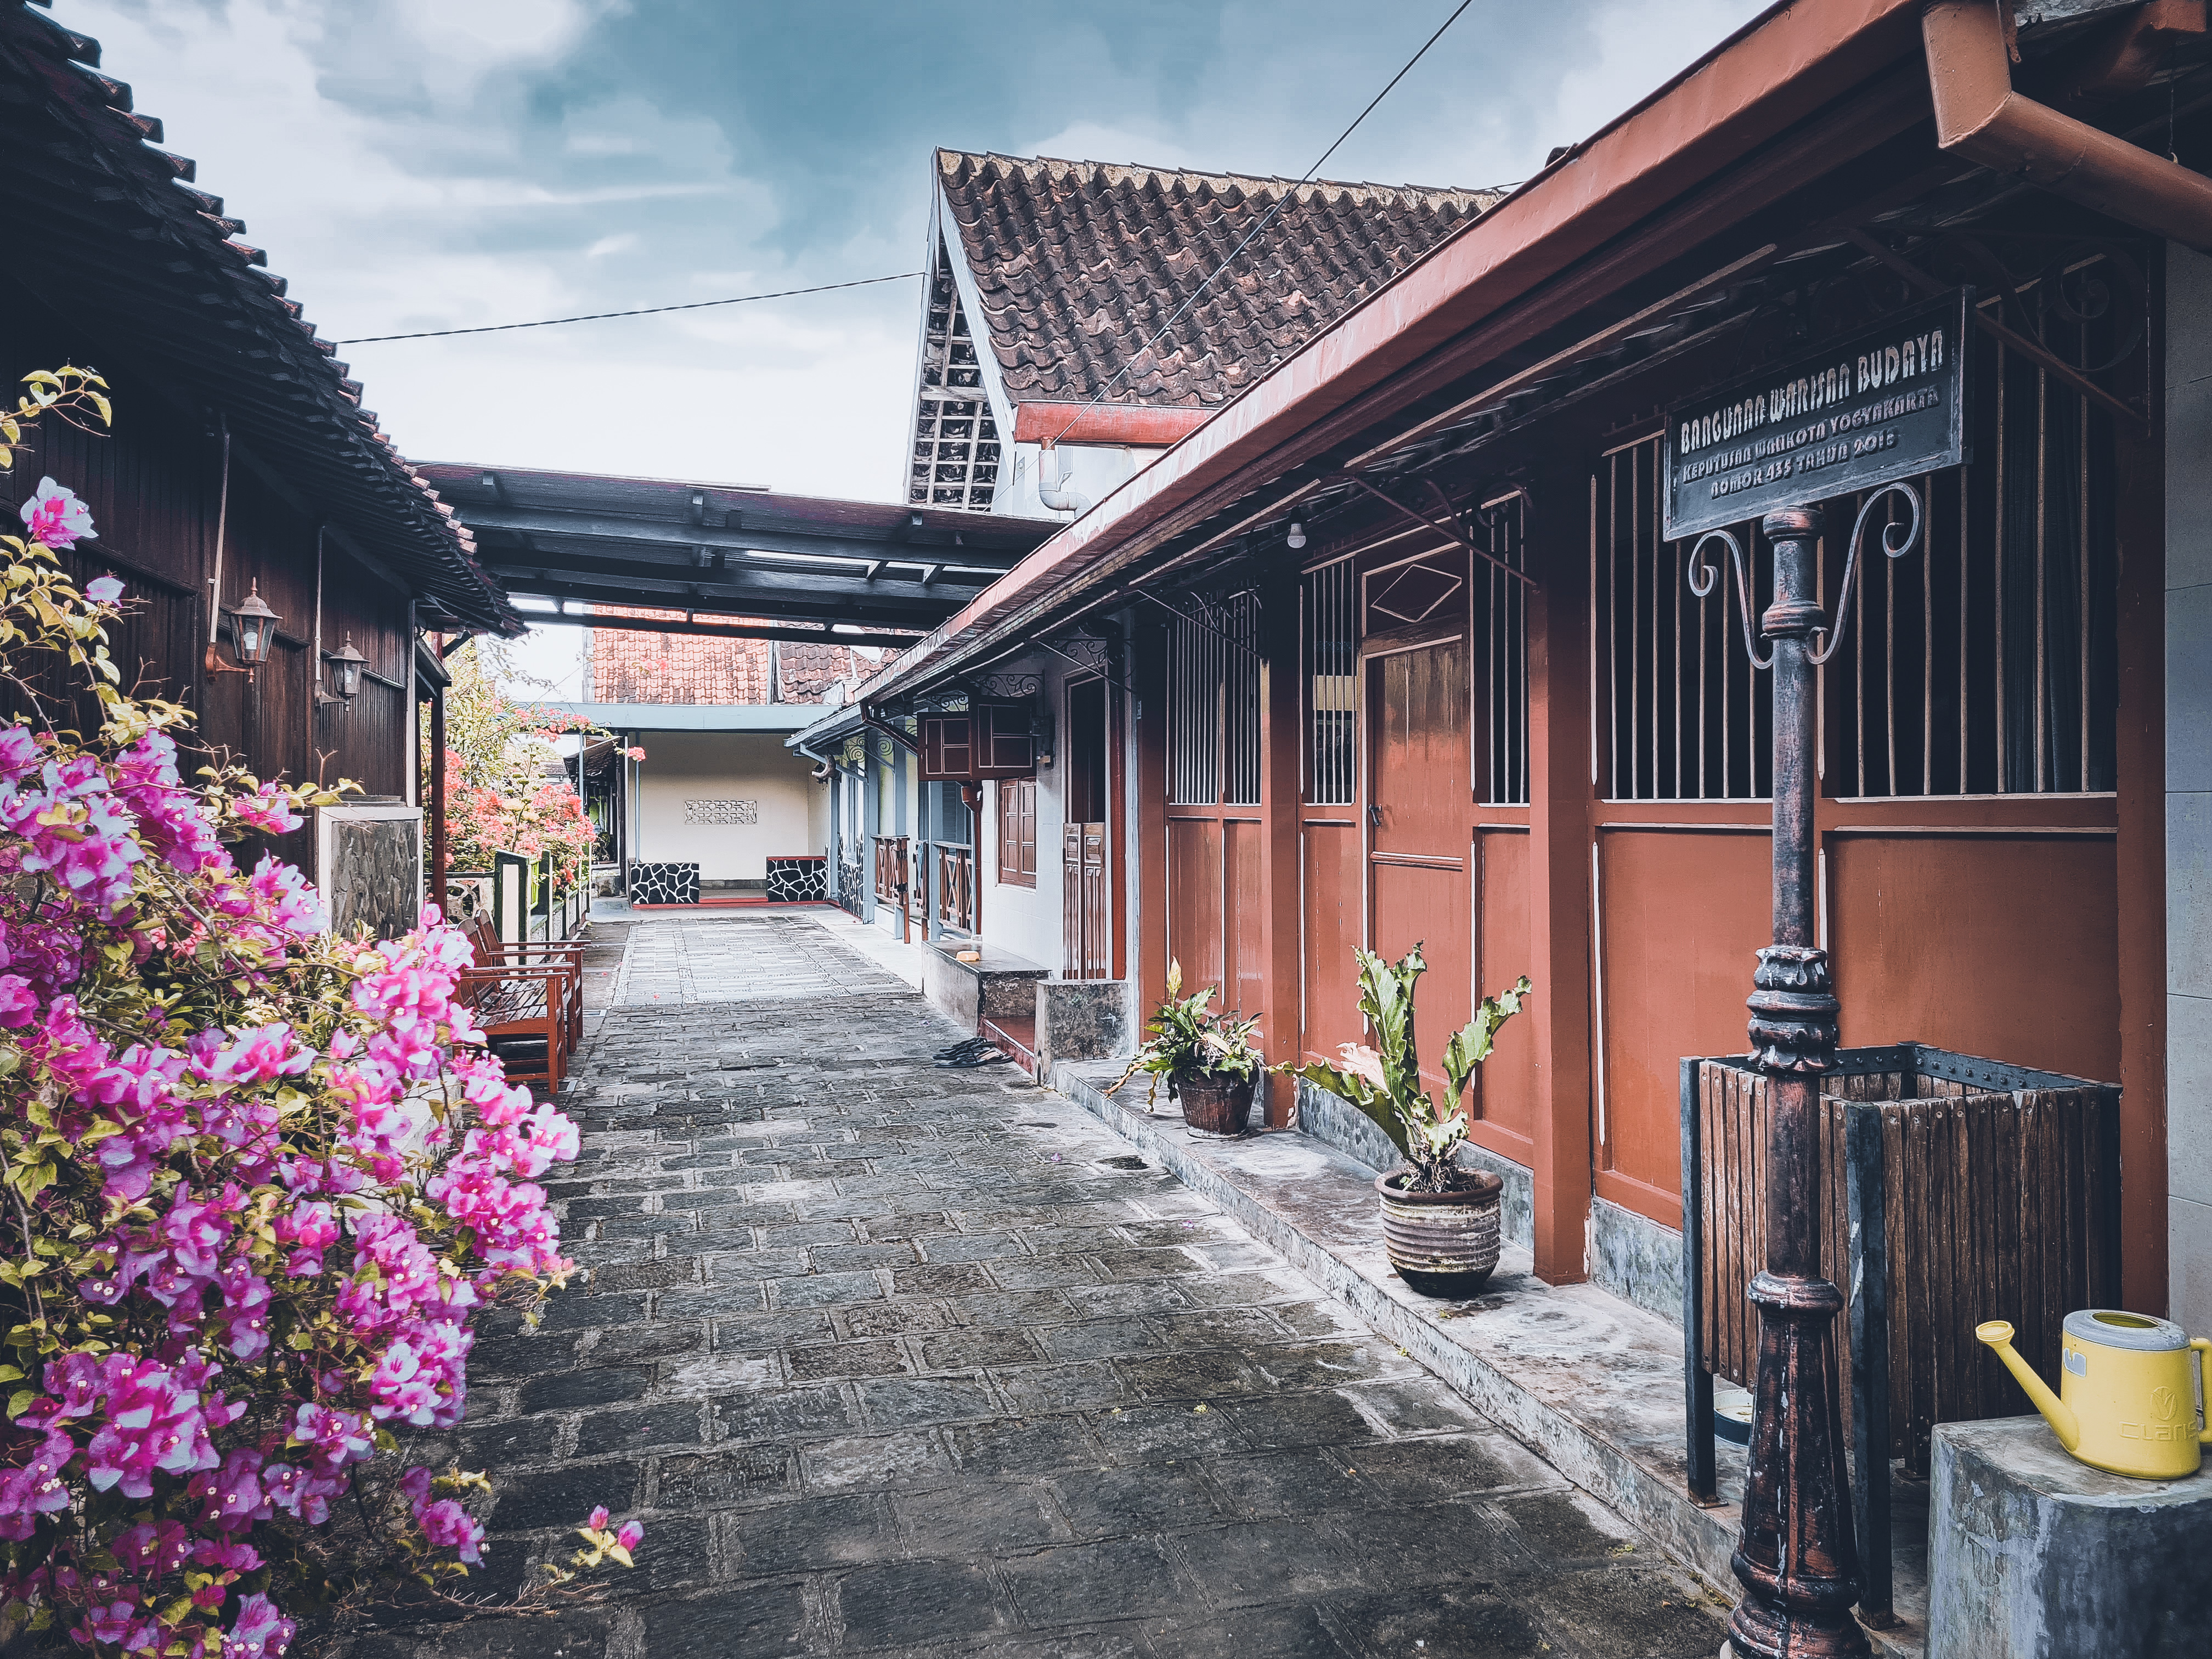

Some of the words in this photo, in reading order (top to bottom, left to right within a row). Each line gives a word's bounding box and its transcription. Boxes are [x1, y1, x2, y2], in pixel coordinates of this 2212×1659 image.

[1681, 394, 1765, 454] BANGUNAN
[1770, 364, 1850, 423] WARISAN
[1858, 330, 1944, 393] BUDAYA
[1683, 447, 1751, 483] KEPUTUSAN
[1830, 386, 1938, 435] YOGYAKARTA
[1711, 469, 1763, 498] NOMOR
[1796, 443, 1848, 472] TAHUN
